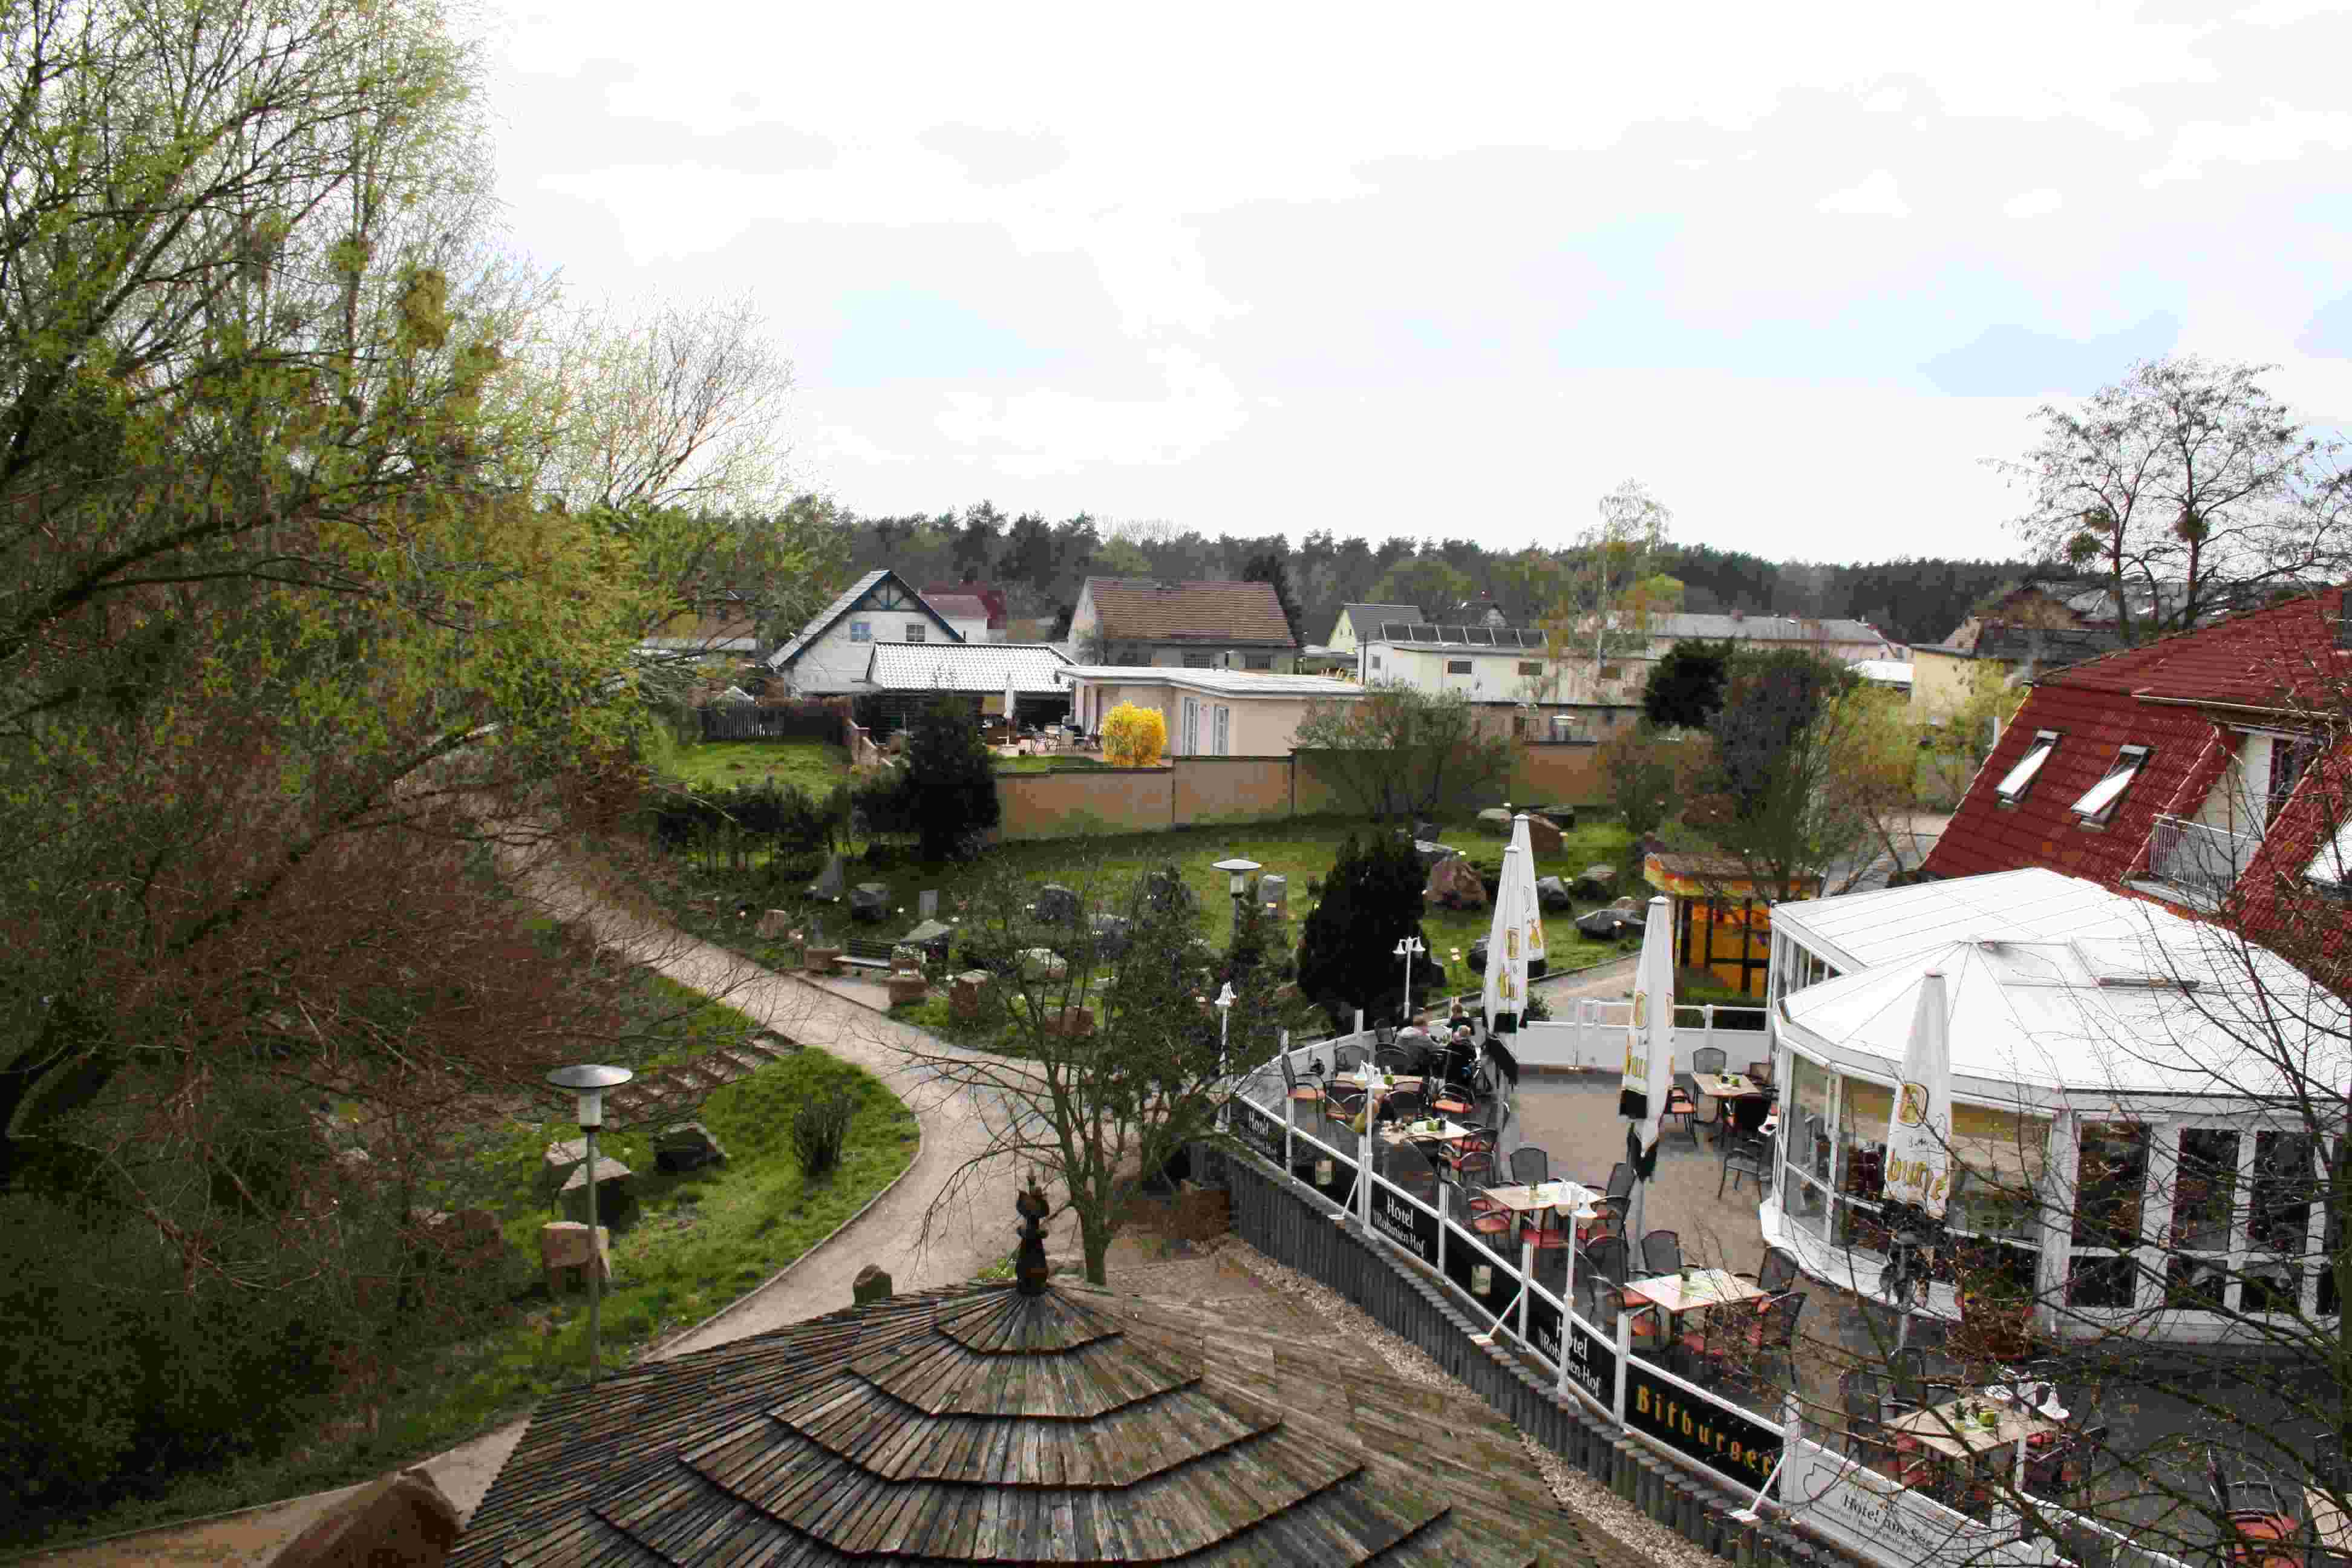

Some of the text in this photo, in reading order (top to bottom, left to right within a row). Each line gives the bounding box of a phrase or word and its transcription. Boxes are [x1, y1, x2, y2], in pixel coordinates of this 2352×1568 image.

[1387, 1194, 1414, 1230] Hotel
[1540, 1327, 1601, 1397] Robien-Hof
[1636, 1383, 1776, 1478] Bitburger
[1843, 1494, 1880, 1523] Hotel
